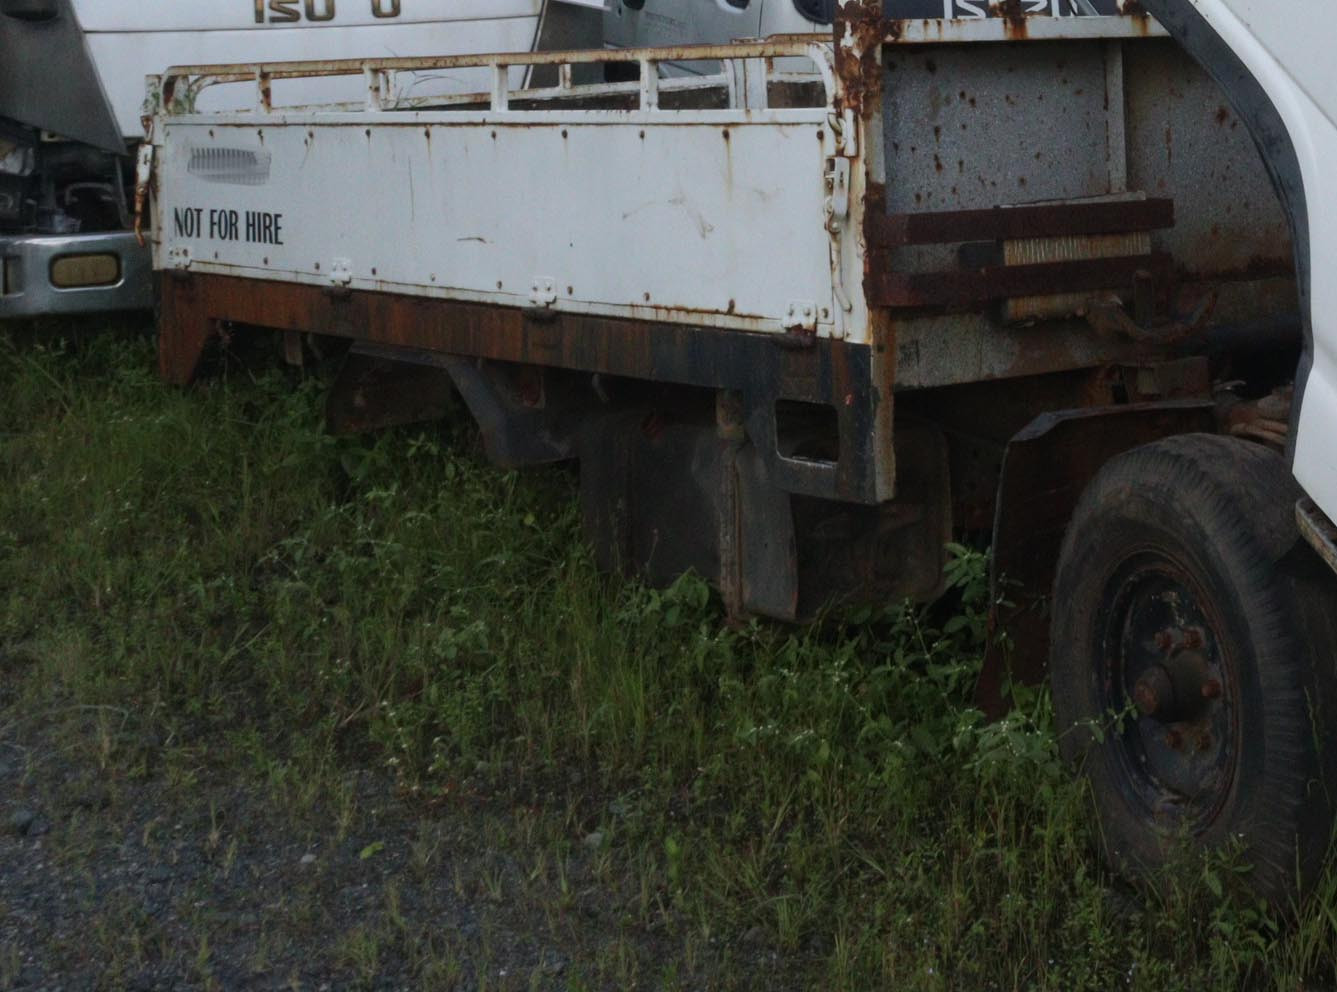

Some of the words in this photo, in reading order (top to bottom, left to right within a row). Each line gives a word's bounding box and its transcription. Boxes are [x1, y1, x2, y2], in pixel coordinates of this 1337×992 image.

[174, 207, 203, 239] NOT
[209, 209, 239, 241] FOR
[245, 210, 284, 246] HIRE
